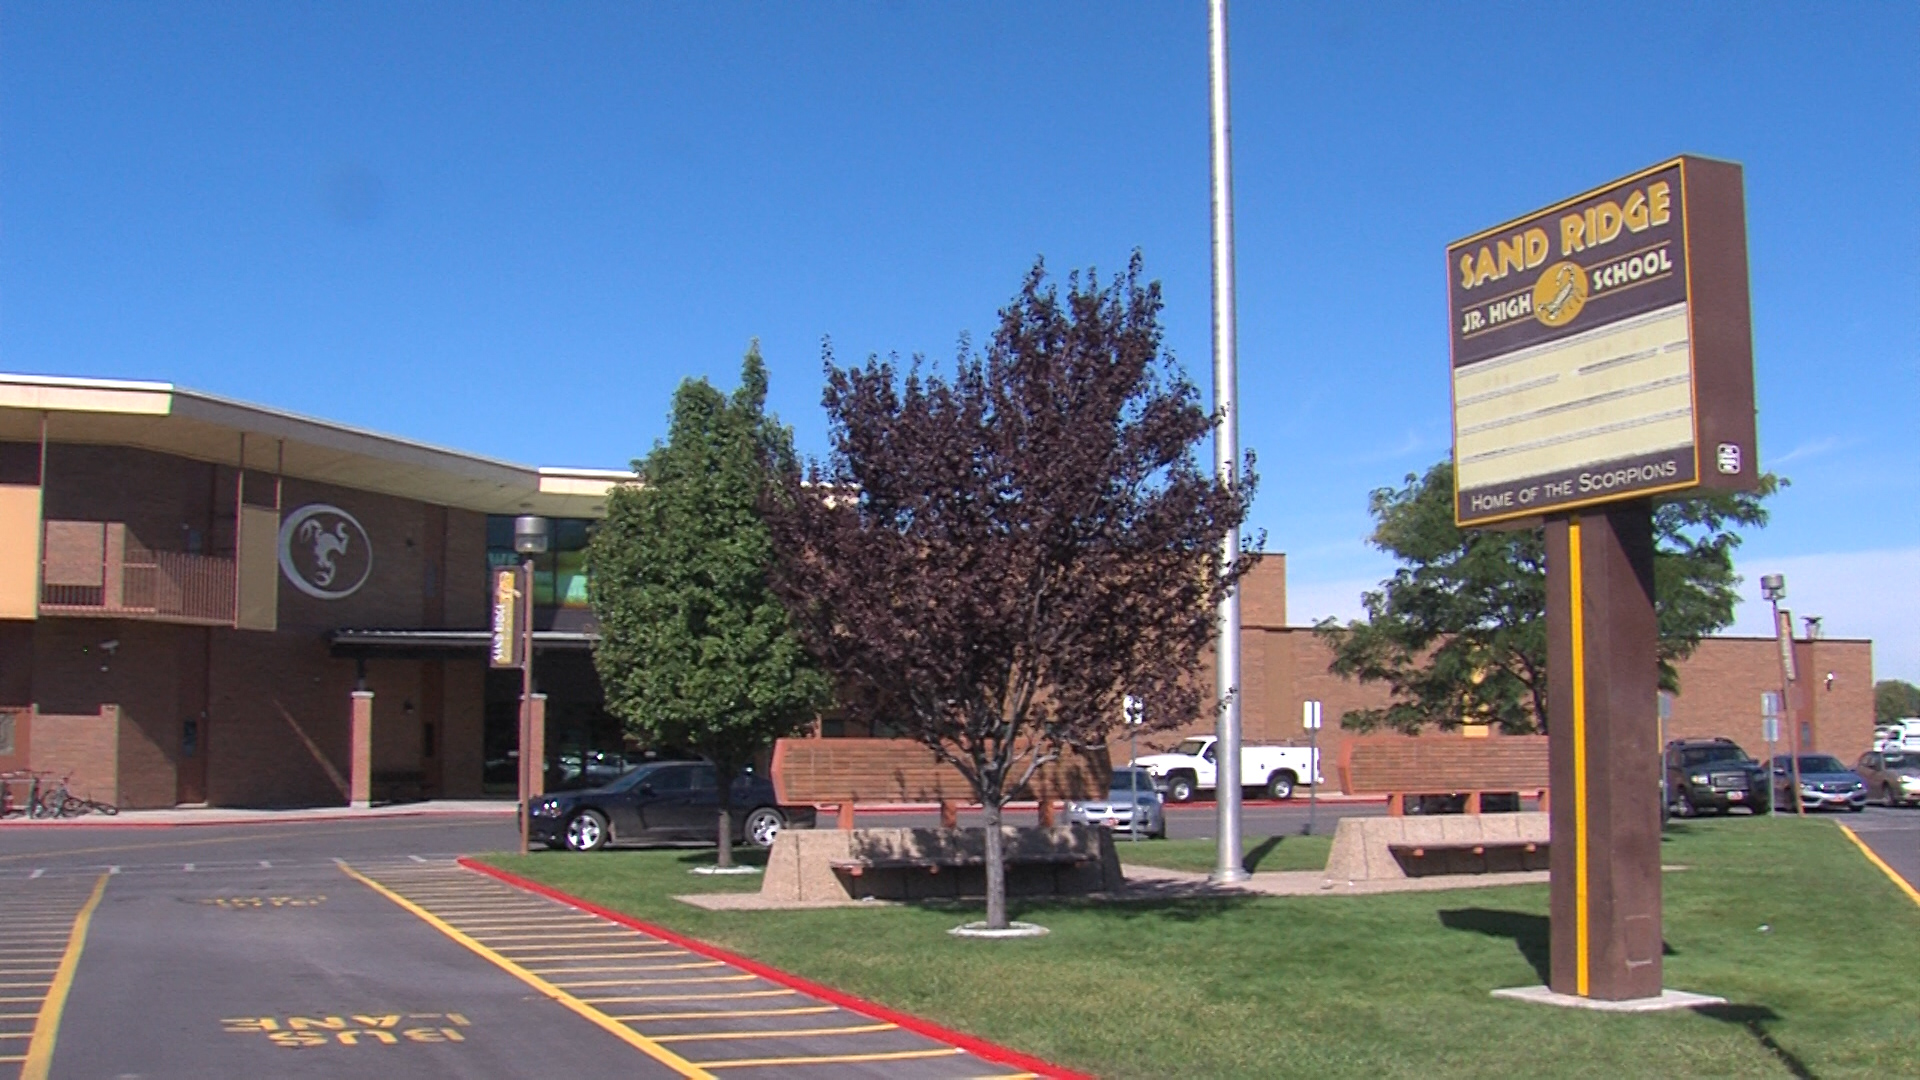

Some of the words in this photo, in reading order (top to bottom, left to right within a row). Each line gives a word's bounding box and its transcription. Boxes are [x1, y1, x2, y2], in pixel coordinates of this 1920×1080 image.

[1460, 227, 1549, 289] SAND
[1560, 181, 1671, 256] RIDGE
[1593, 248, 1673, 291] SCHOOL
[1462, 309, 1486, 334] JR.
[1489, 293, 1532, 324] HIGH
[1471, 489, 1514, 512] HOME
[1519, 486, 1541, 504] OF
[1543, 479, 1573, 497] THE
[220, 1014, 471, 1032] LANE
[268, 1029, 465, 1047] BUS
